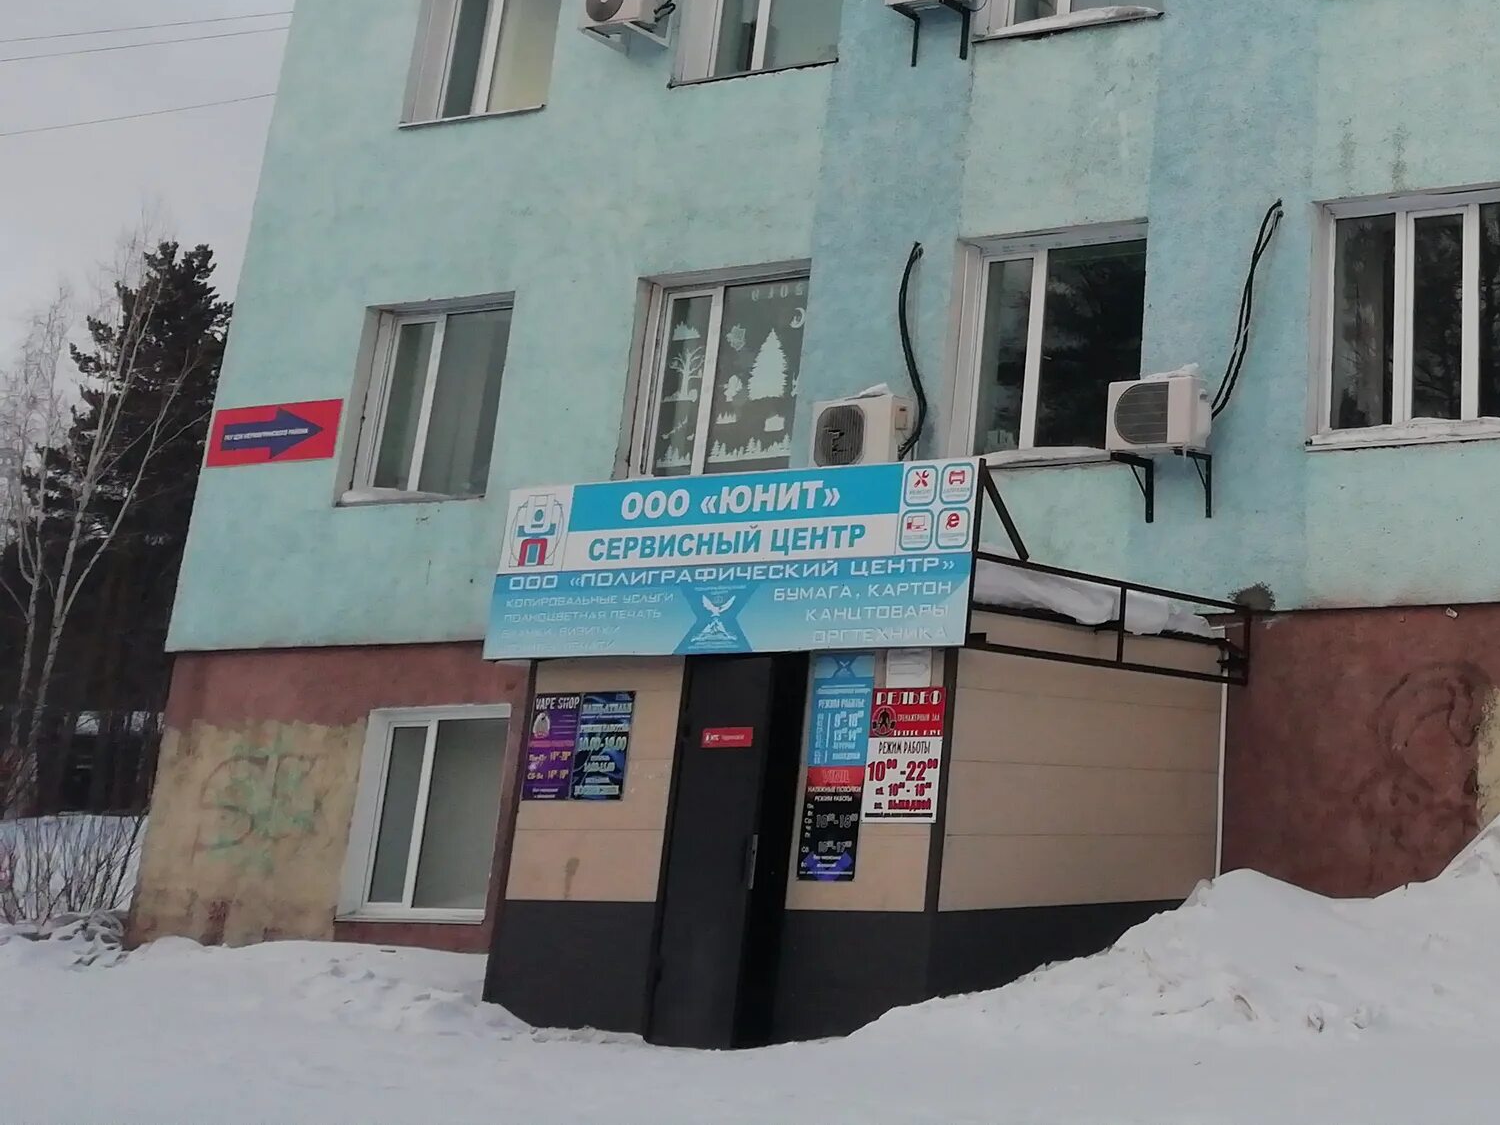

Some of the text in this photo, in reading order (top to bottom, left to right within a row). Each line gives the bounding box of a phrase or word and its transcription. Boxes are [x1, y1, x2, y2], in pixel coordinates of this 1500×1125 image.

[621, 479, 841, 521] ООО «ЮНИТ»
[588, 523, 867, 562] СЕРВИСНЫЙ ЦЕНТР
[508, 557, 955, 590] ООО «ПОЛИГРАФИЧЕСКИЙ ЦЕНТР»
[506, 592, 674, 609] КОПИРОВАЛЬНЫЕ УСЛУГИ
[773, 581, 952, 603] БУМАГА, КАРТОН
[609, 608, 662, 620] ПЕЧАТЬ
[805, 604, 949, 622] КАНЦТОВАРЫ
[812, 626, 949, 644] ОРГТЕХНИКА
[535, 697, 556, 710] VAPE
[557, 696, 580, 709] SHOP
[878, 741, 931, 754] РЕЖИМ РАБОТЫ
